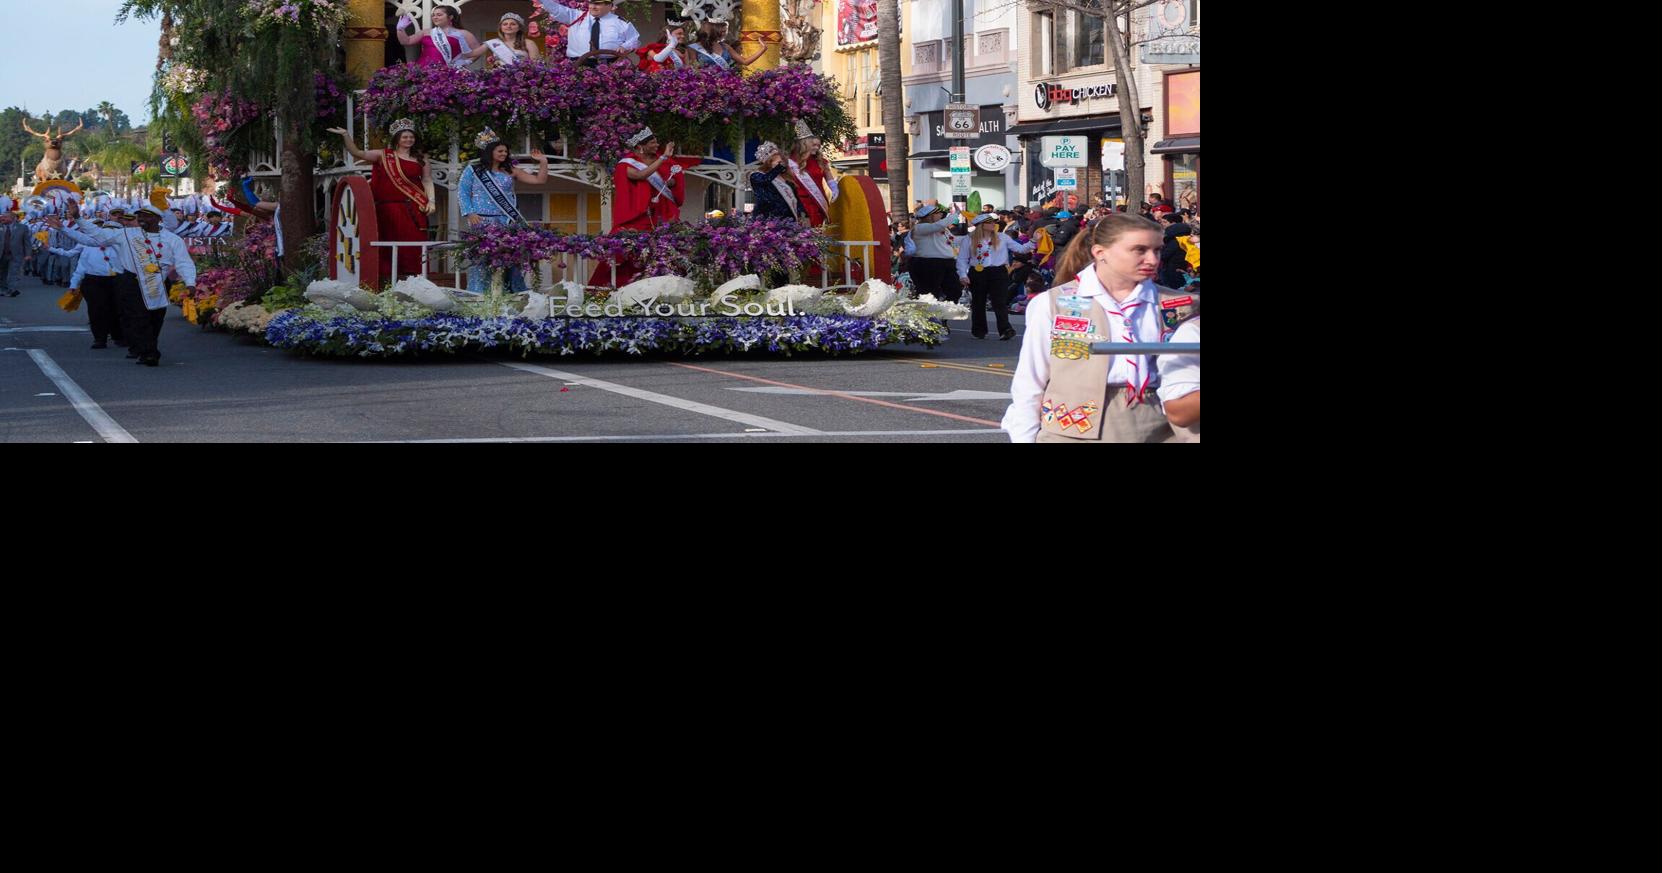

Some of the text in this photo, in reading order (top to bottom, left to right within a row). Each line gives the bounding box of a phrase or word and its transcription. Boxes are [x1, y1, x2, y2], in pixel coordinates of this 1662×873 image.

[1072, 83, 1112, 99] CHICKEN
[954, 120, 970, 129] 66
[549, 294, 806, 318] Feed Your Soul.
